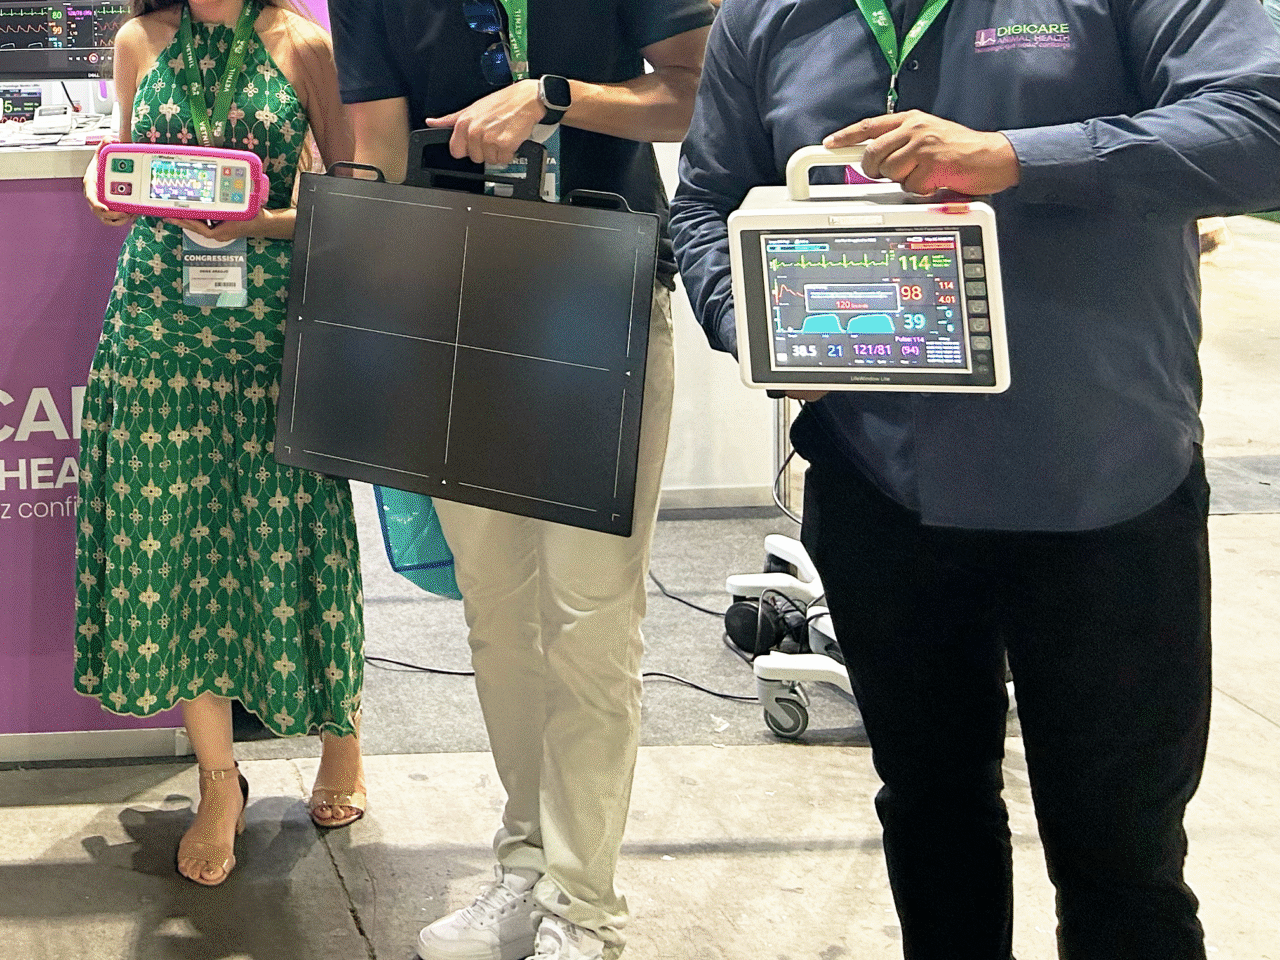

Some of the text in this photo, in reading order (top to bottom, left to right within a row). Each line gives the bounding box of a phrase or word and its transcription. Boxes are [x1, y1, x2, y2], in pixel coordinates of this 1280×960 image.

[997, 23, 1070, 37] DIGICARE
[186, 42, 195, 68] VETNIL
[184, 254, 245, 262] CONGRESSISTA
[898, 254, 931, 271] 114
[901, 285, 923, 301] 98
[939, 281, 954, 290] 114
[836, 300, 851, 310] 120
[903, 313, 926, 330] 39
[827, 344, 844, 357] 21
[853, 344, 892, 355] 121/81
